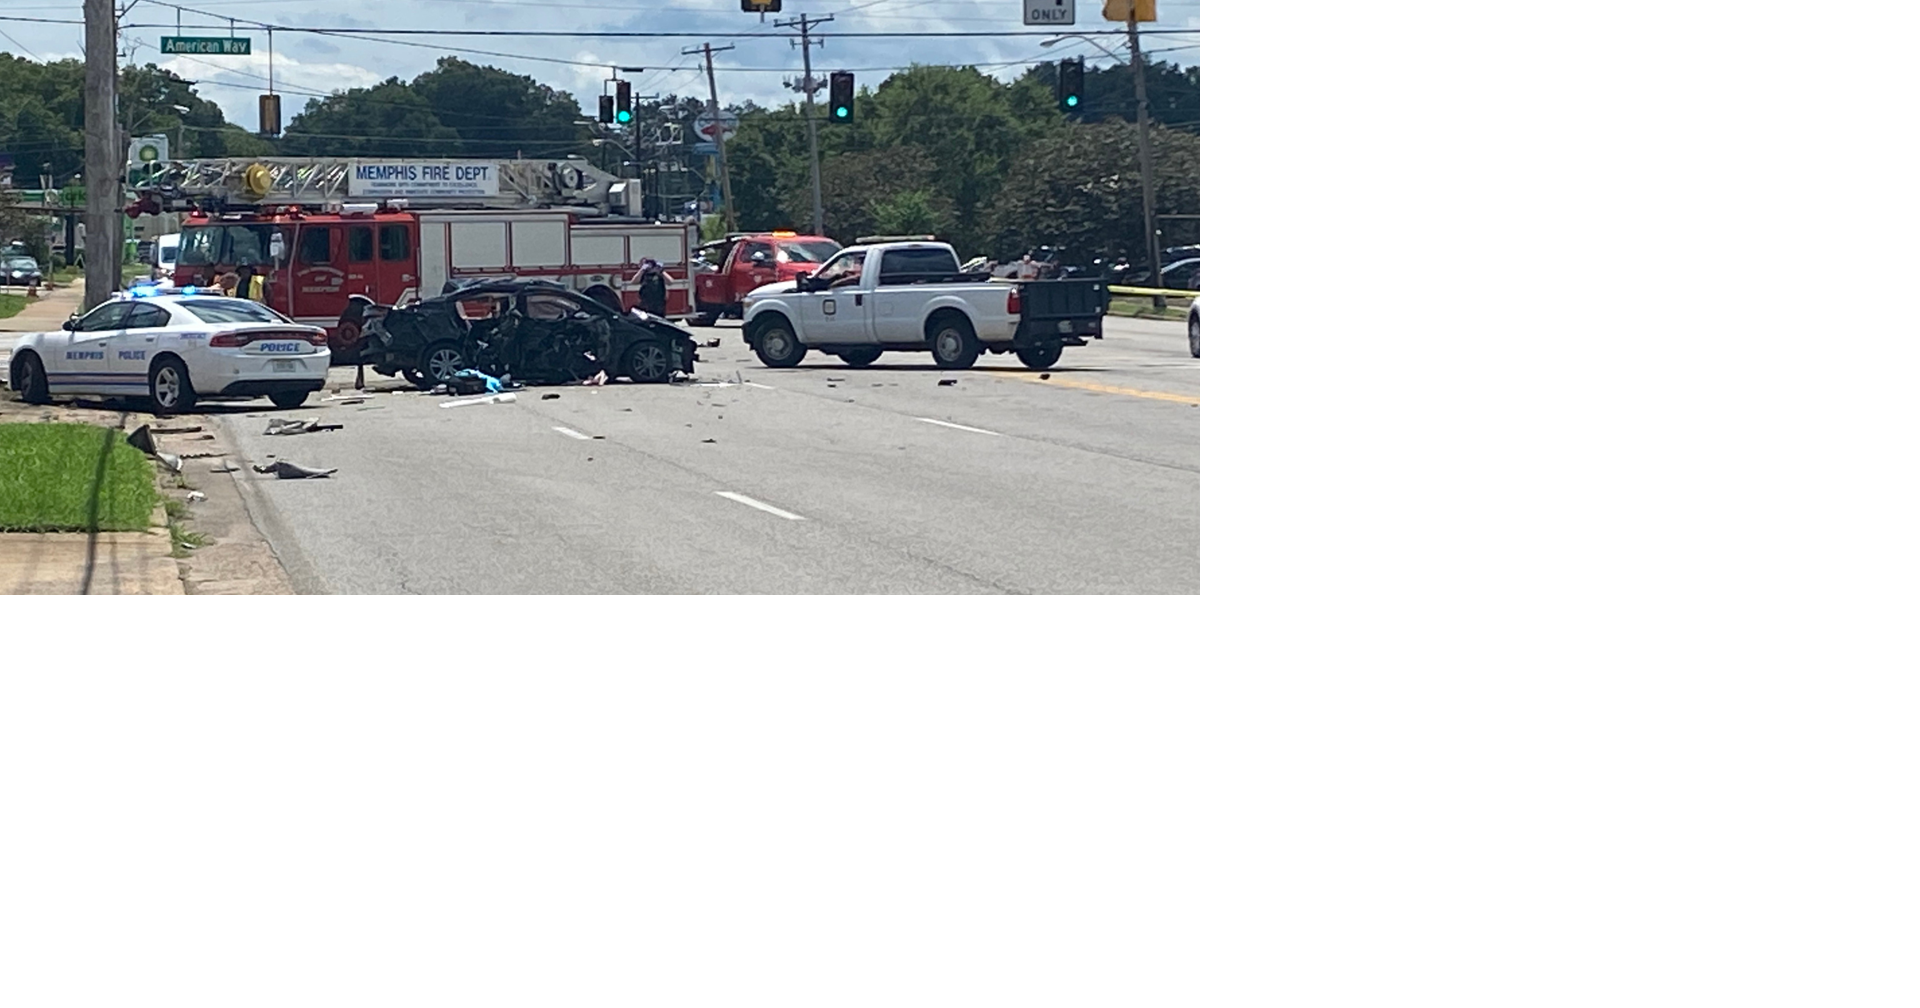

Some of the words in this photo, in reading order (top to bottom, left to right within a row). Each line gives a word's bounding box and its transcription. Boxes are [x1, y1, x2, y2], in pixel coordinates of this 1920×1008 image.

[1031, 9, 1067, 21] ONLY
[166, 38, 220, 52] American
[222, 39, 247, 53] Way
[356, 165, 417, 180] MEMPHIS
[422, 166, 450, 180] FIRE
[260, 343, 300, 352] POLICE
[66, 351, 104, 360] MEMPHIS
[118, 350, 146, 360] POLICE
